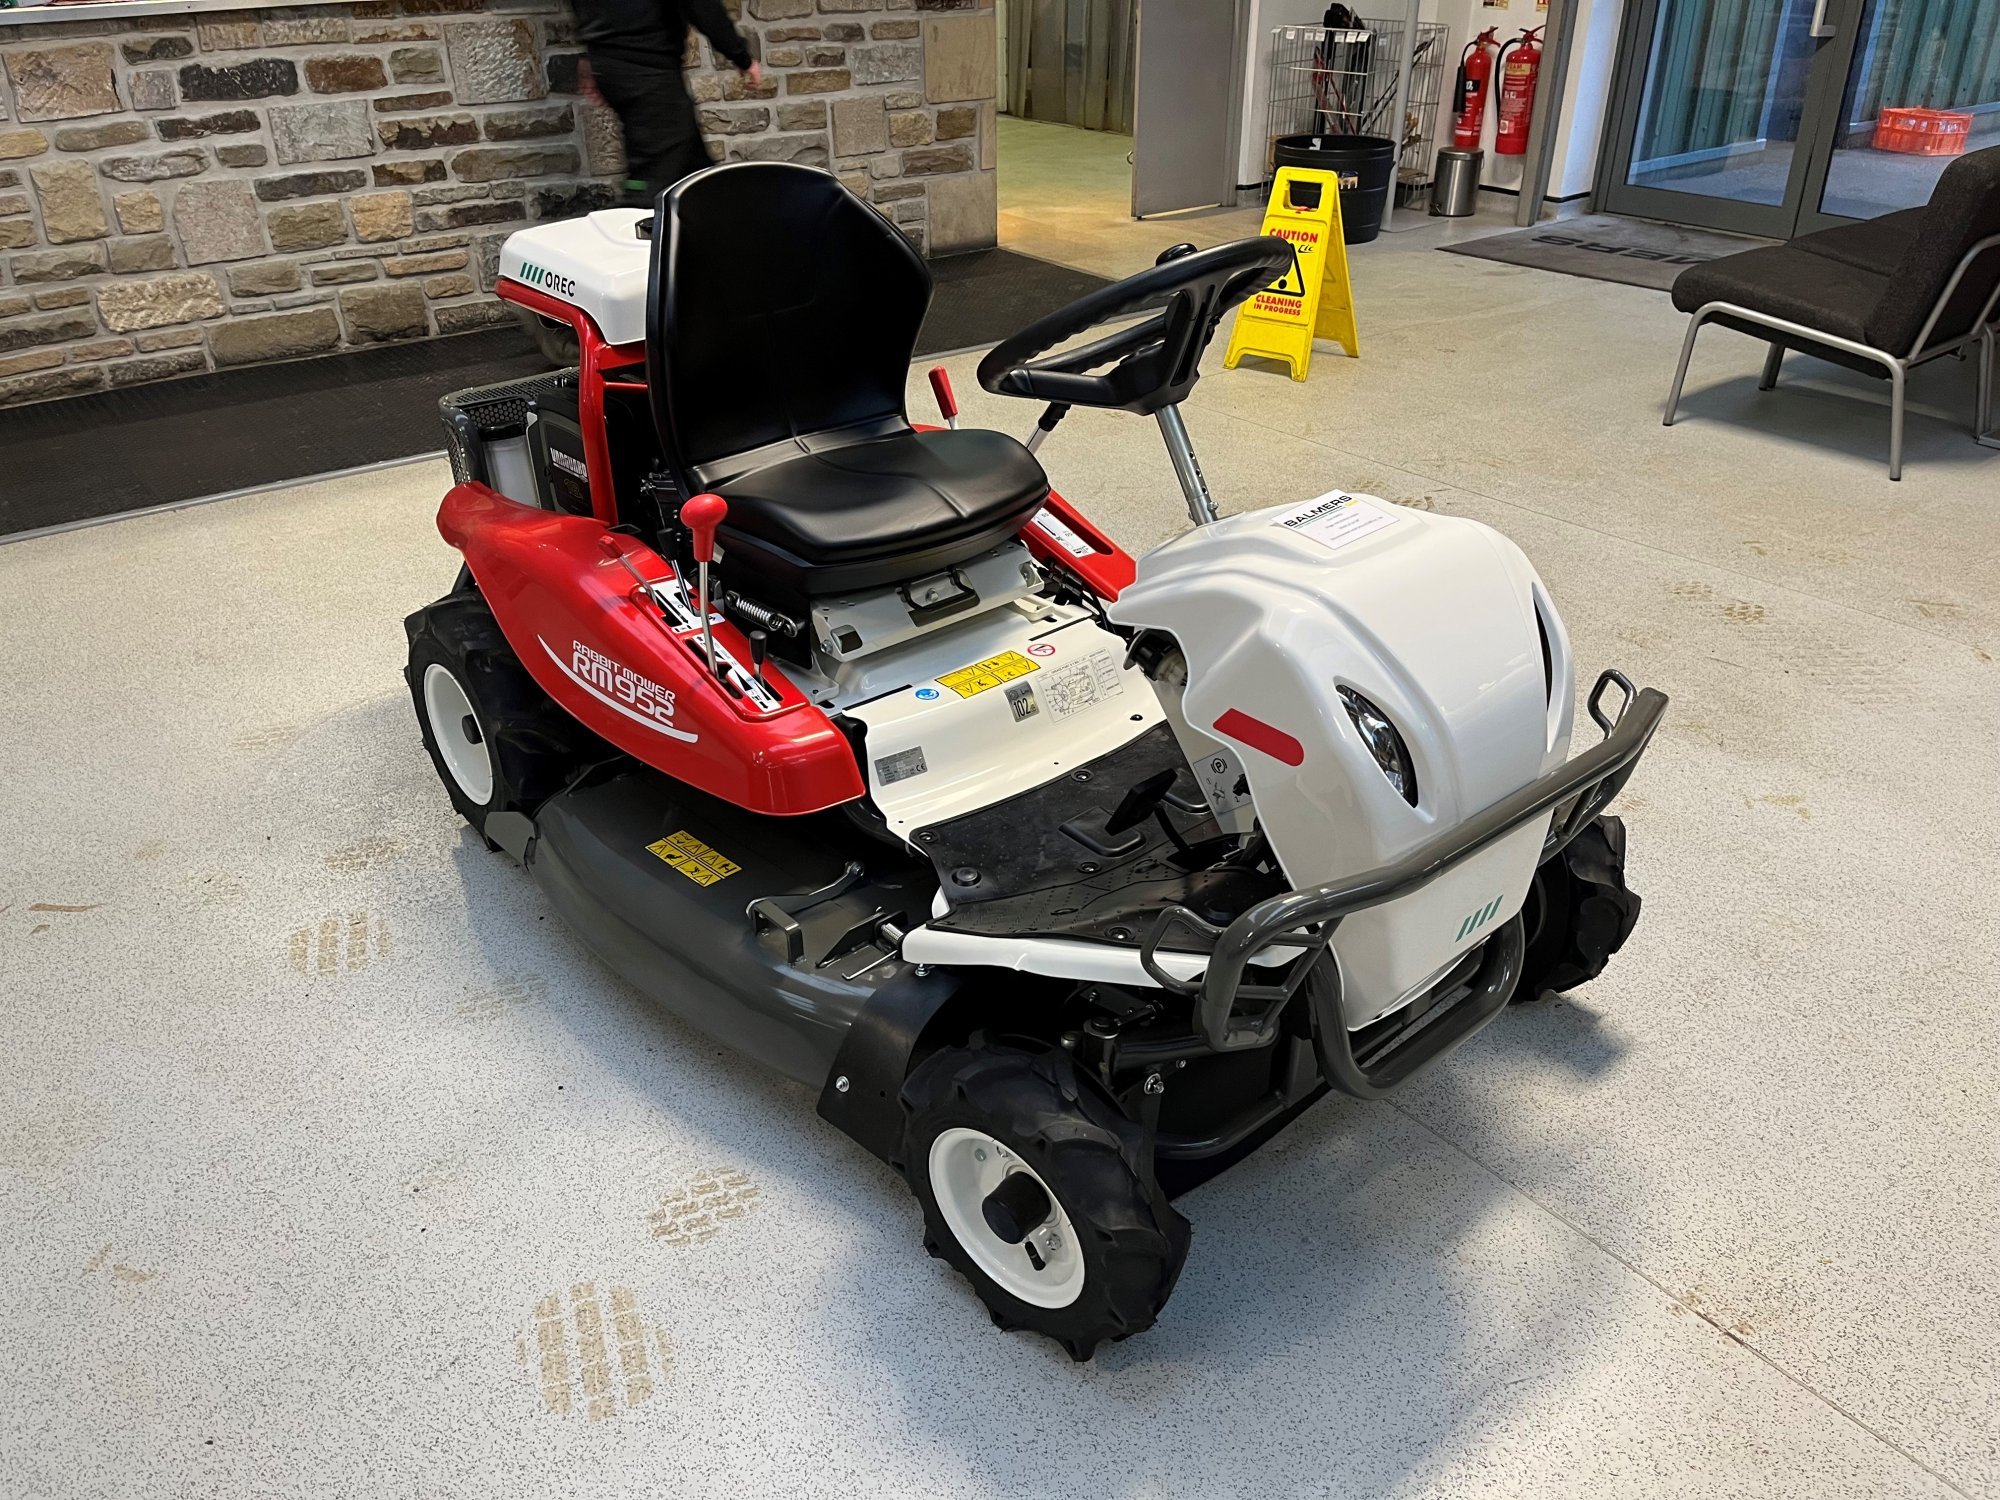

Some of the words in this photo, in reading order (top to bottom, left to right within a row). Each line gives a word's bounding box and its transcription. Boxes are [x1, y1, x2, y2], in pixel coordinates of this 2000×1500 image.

[1269, 229, 1318, 243] CAUTION
[545, 271, 576, 298] OREC
[1253, 302, 1262, 310] IN
[1263, 304, 1301, 316] PROGRESS
[1256, 295, 1302, 308] CLEANING
[1283, 495, 1353, 527] BALMERS
[573, 640, 620, 673] RABBIT
[622, 668, 675, 704] MOWER
[573, 651, 674, 727] RM952
[1013, 697, 1031, 718] 102
